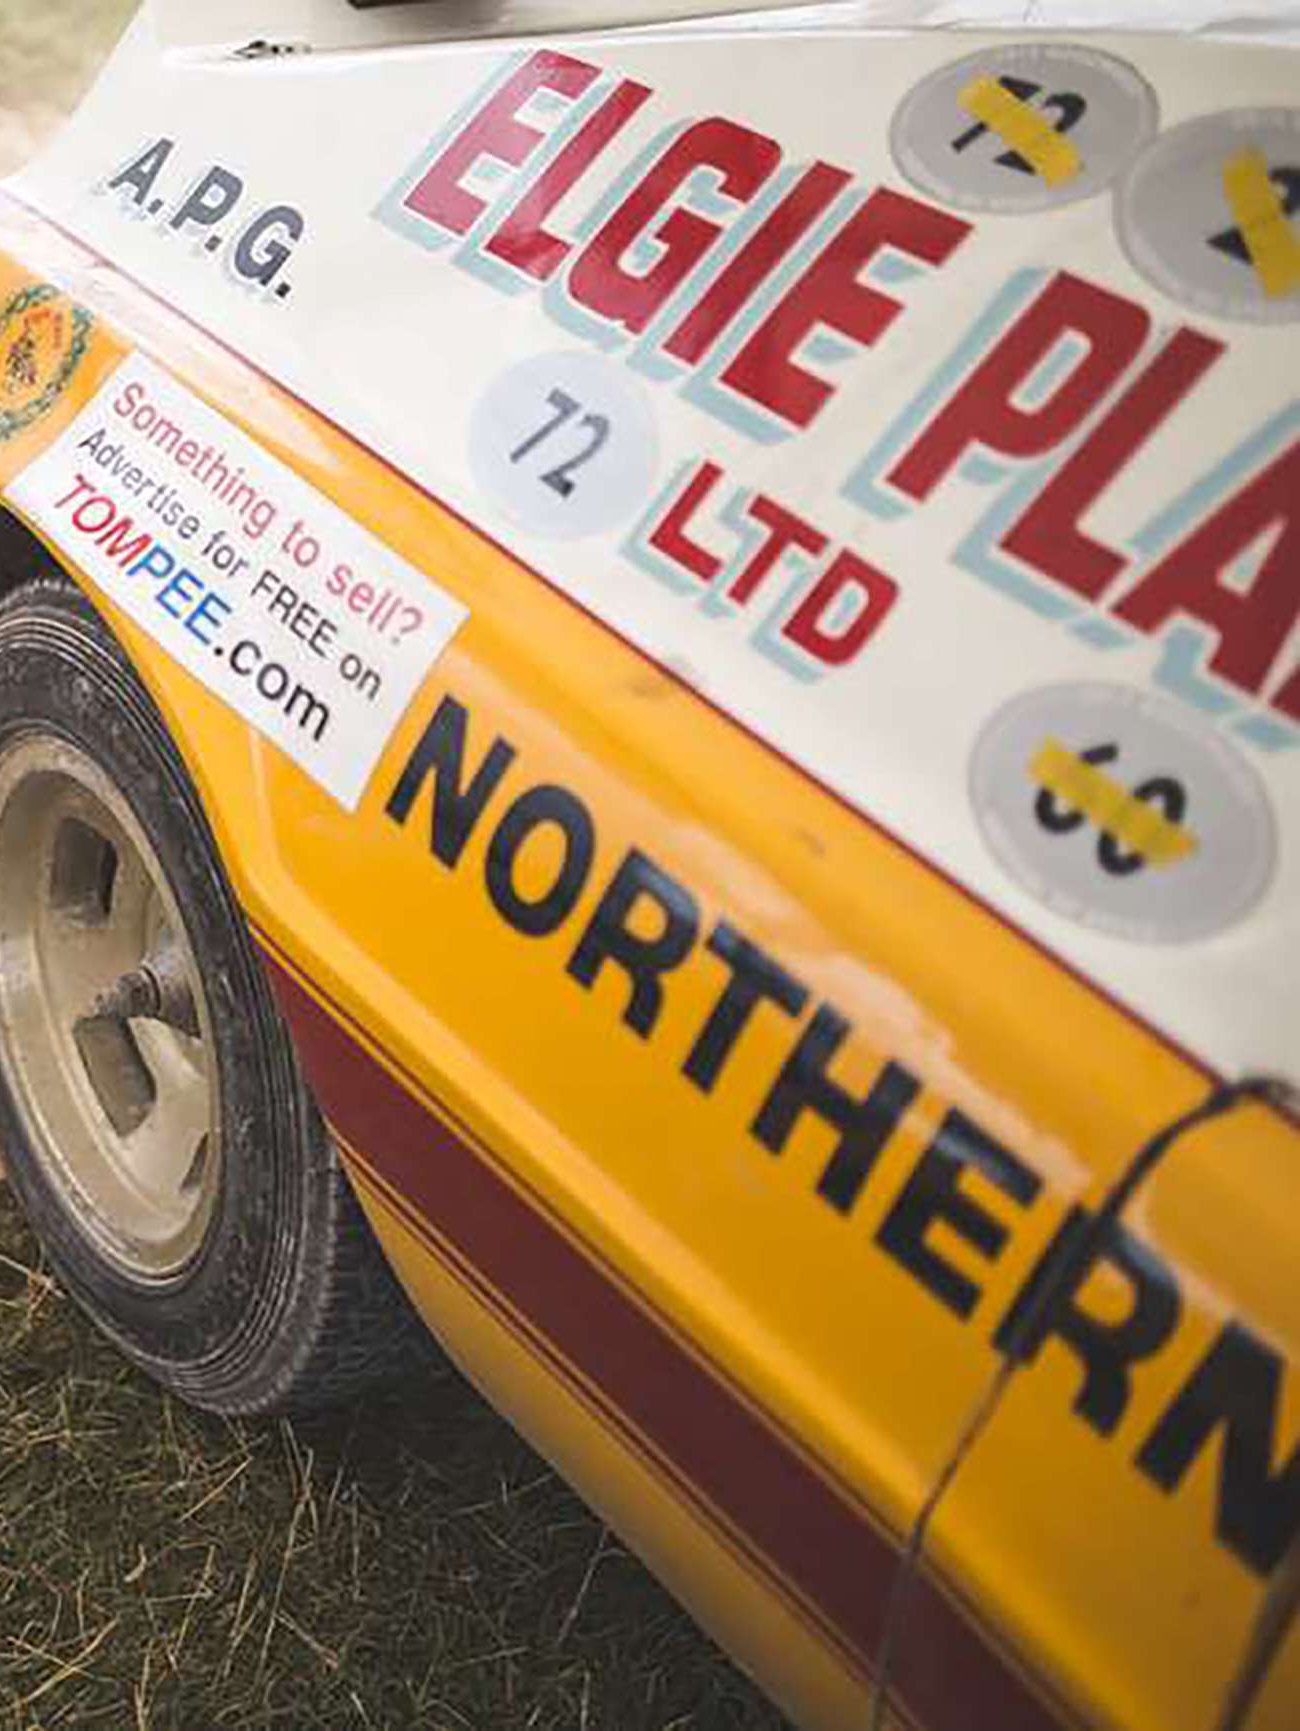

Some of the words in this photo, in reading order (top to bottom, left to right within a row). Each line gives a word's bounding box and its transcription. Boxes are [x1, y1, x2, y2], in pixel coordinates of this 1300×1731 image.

[108, 138, 304, 297] A.P.G.
[113, 383, 277, 540] Something
[282, 521, 319, 568] to
[327, 560, 423, 646] sell?
[404, 49, 974, 430] ELGIE
[886, 271, 1300, 724] PLA
[510, 388, 609, 497] 72
[55, 475, 331, 741] TOMPEE.com
[79, 428, 200, 539] Advertise
[203, 528, 249, 579] for
[252, 570, 339, 658] FREE
[339, 653, 382, 700] on
[649, 460, 899, 666] LTD
[384, 694, 1300, 1579] NORTHERN
